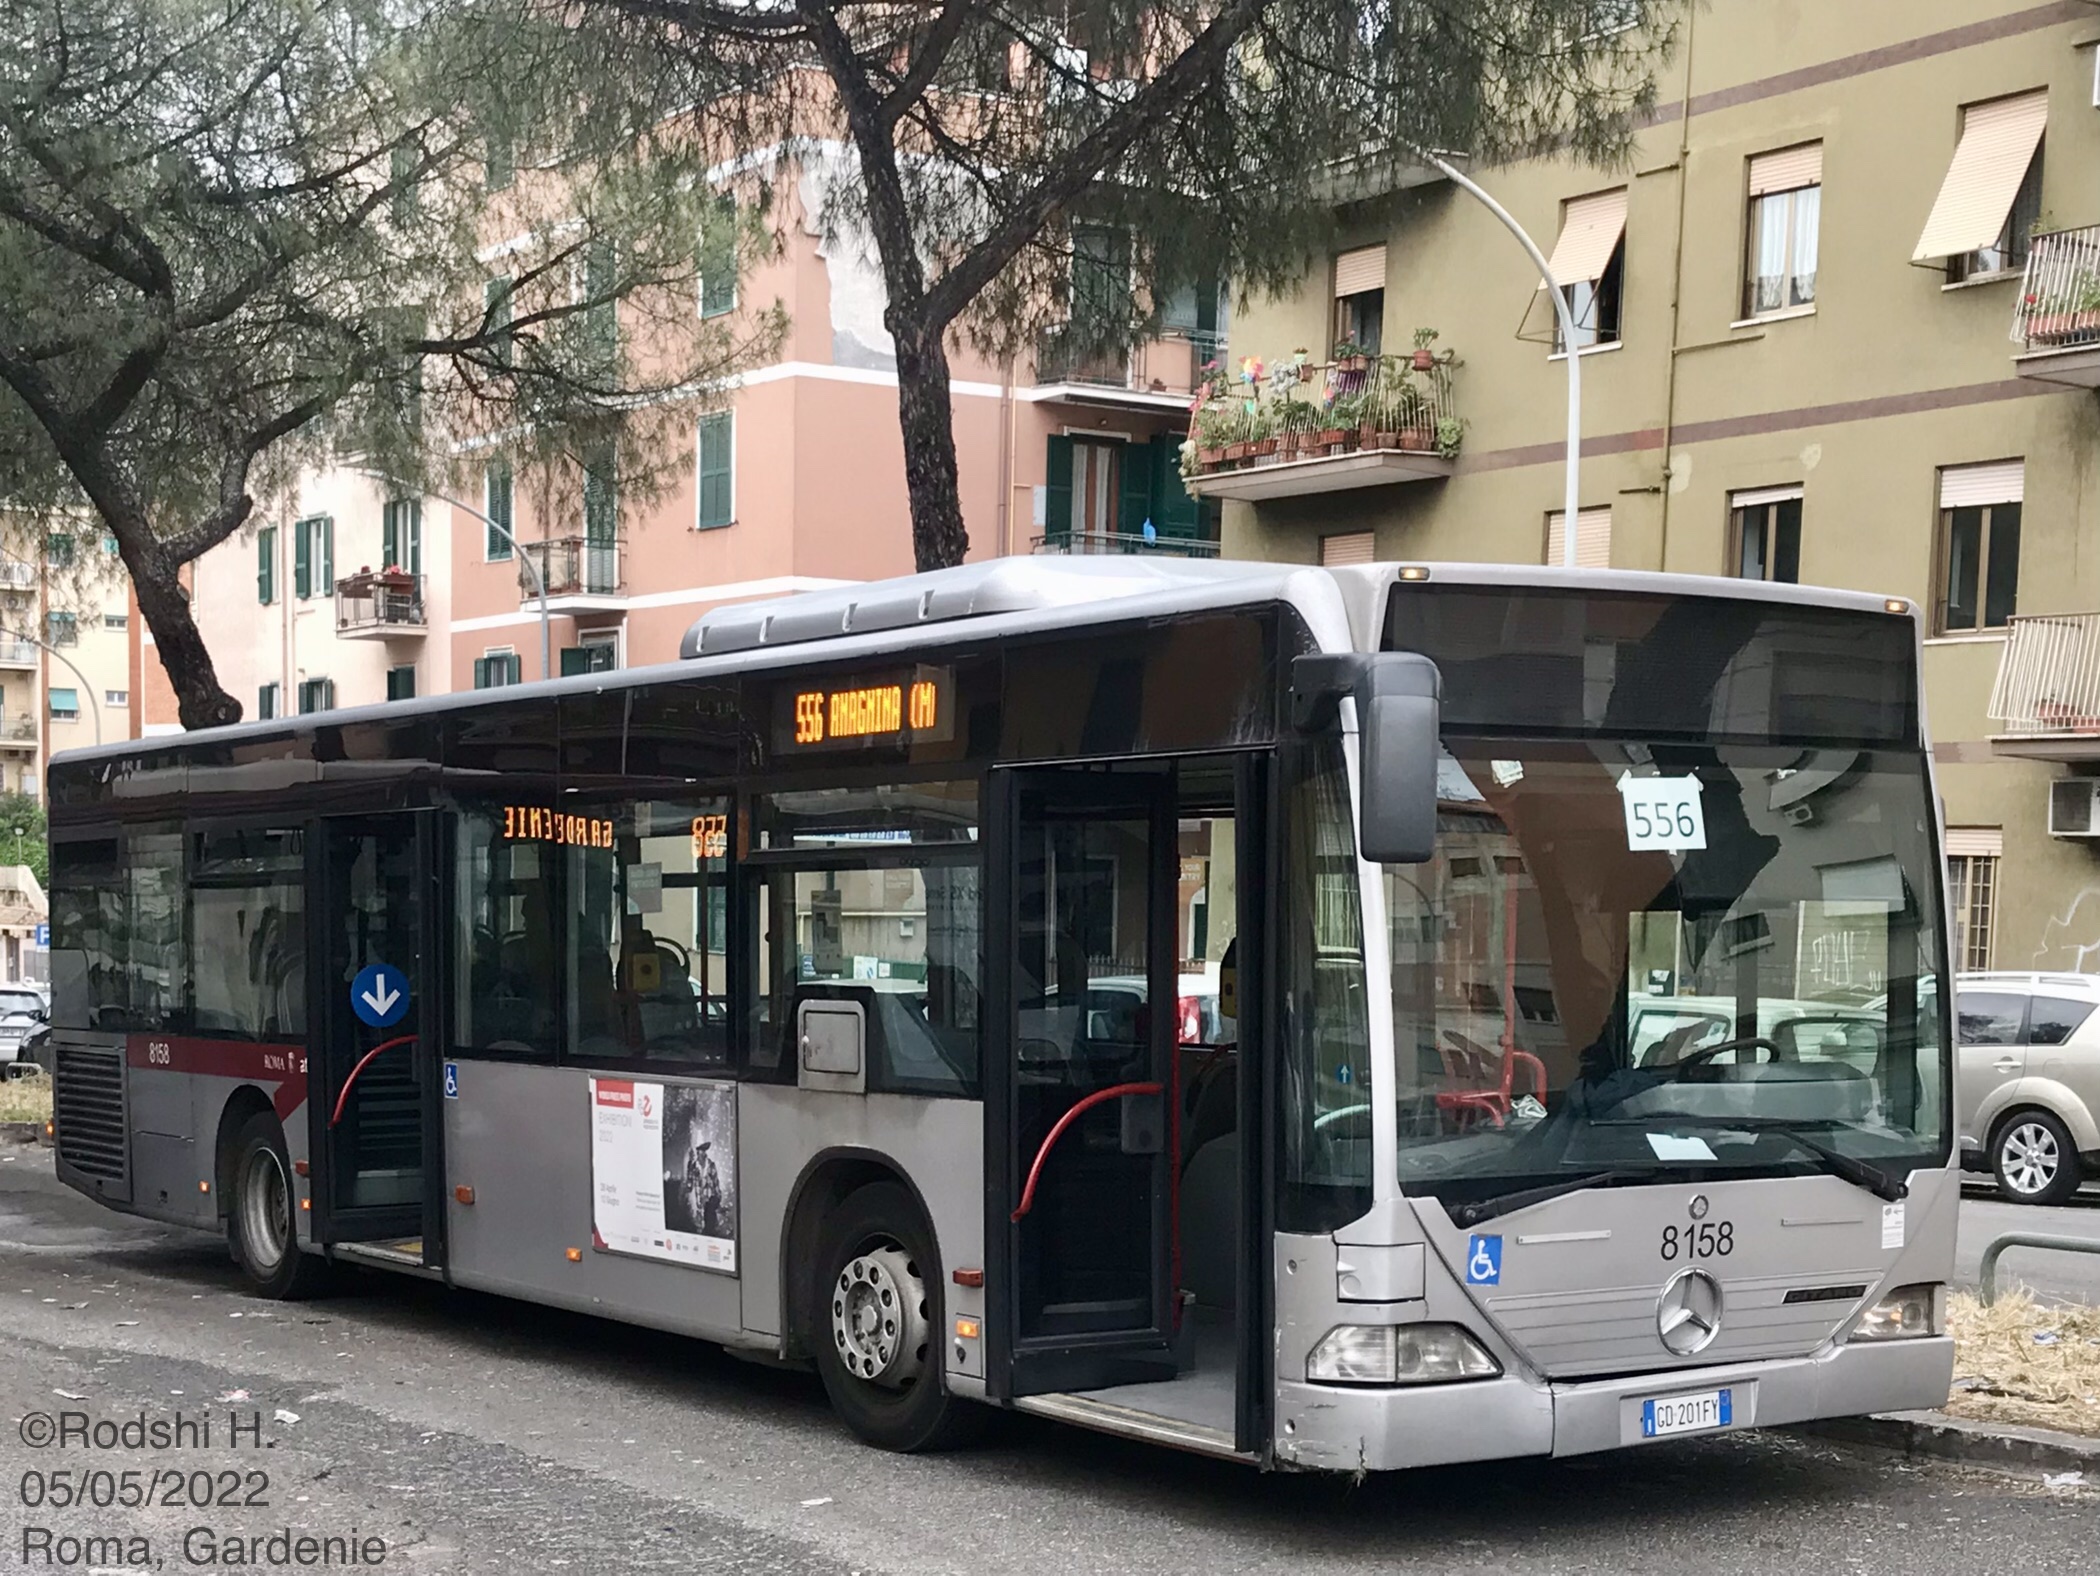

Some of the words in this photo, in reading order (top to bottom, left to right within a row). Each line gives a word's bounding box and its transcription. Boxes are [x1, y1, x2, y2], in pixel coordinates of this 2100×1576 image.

[796, 692, 825, 743] 556
[829, 685, 902, 738] ANAGNINA
[1633, 802, 1695, 838] 556
[149, 1041, 171, 1065] 8158
[1660, 1220, 1734, 1261] 8158
